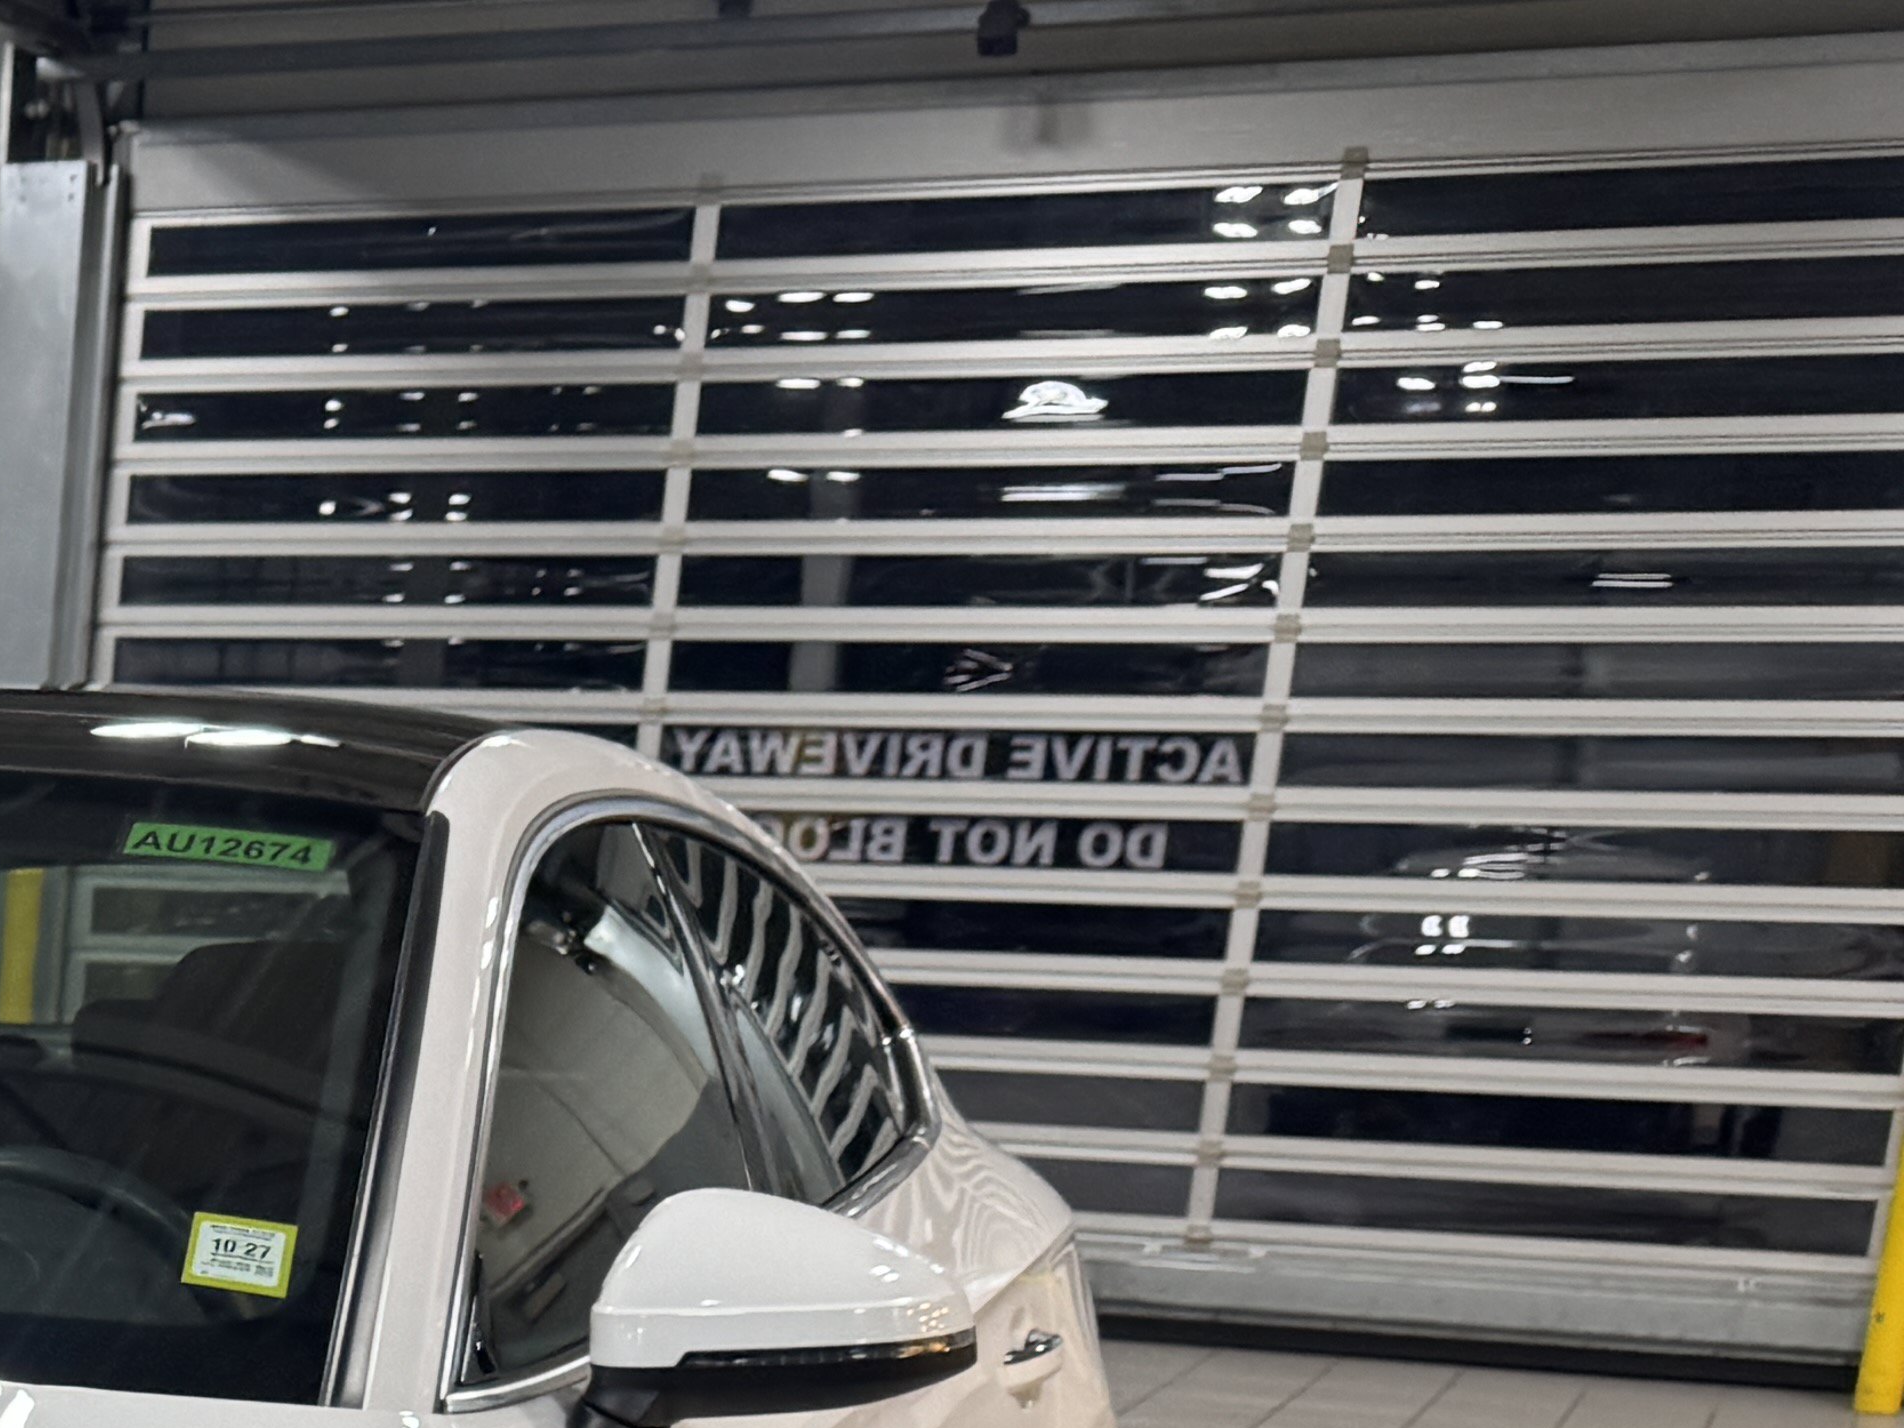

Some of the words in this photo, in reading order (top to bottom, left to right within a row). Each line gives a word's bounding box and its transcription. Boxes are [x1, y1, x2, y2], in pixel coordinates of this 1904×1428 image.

[132, 830, 313, 865] AU12674
[211, 1238, 237, 1253] 10
[244, 1242, 272, 1260] 27
